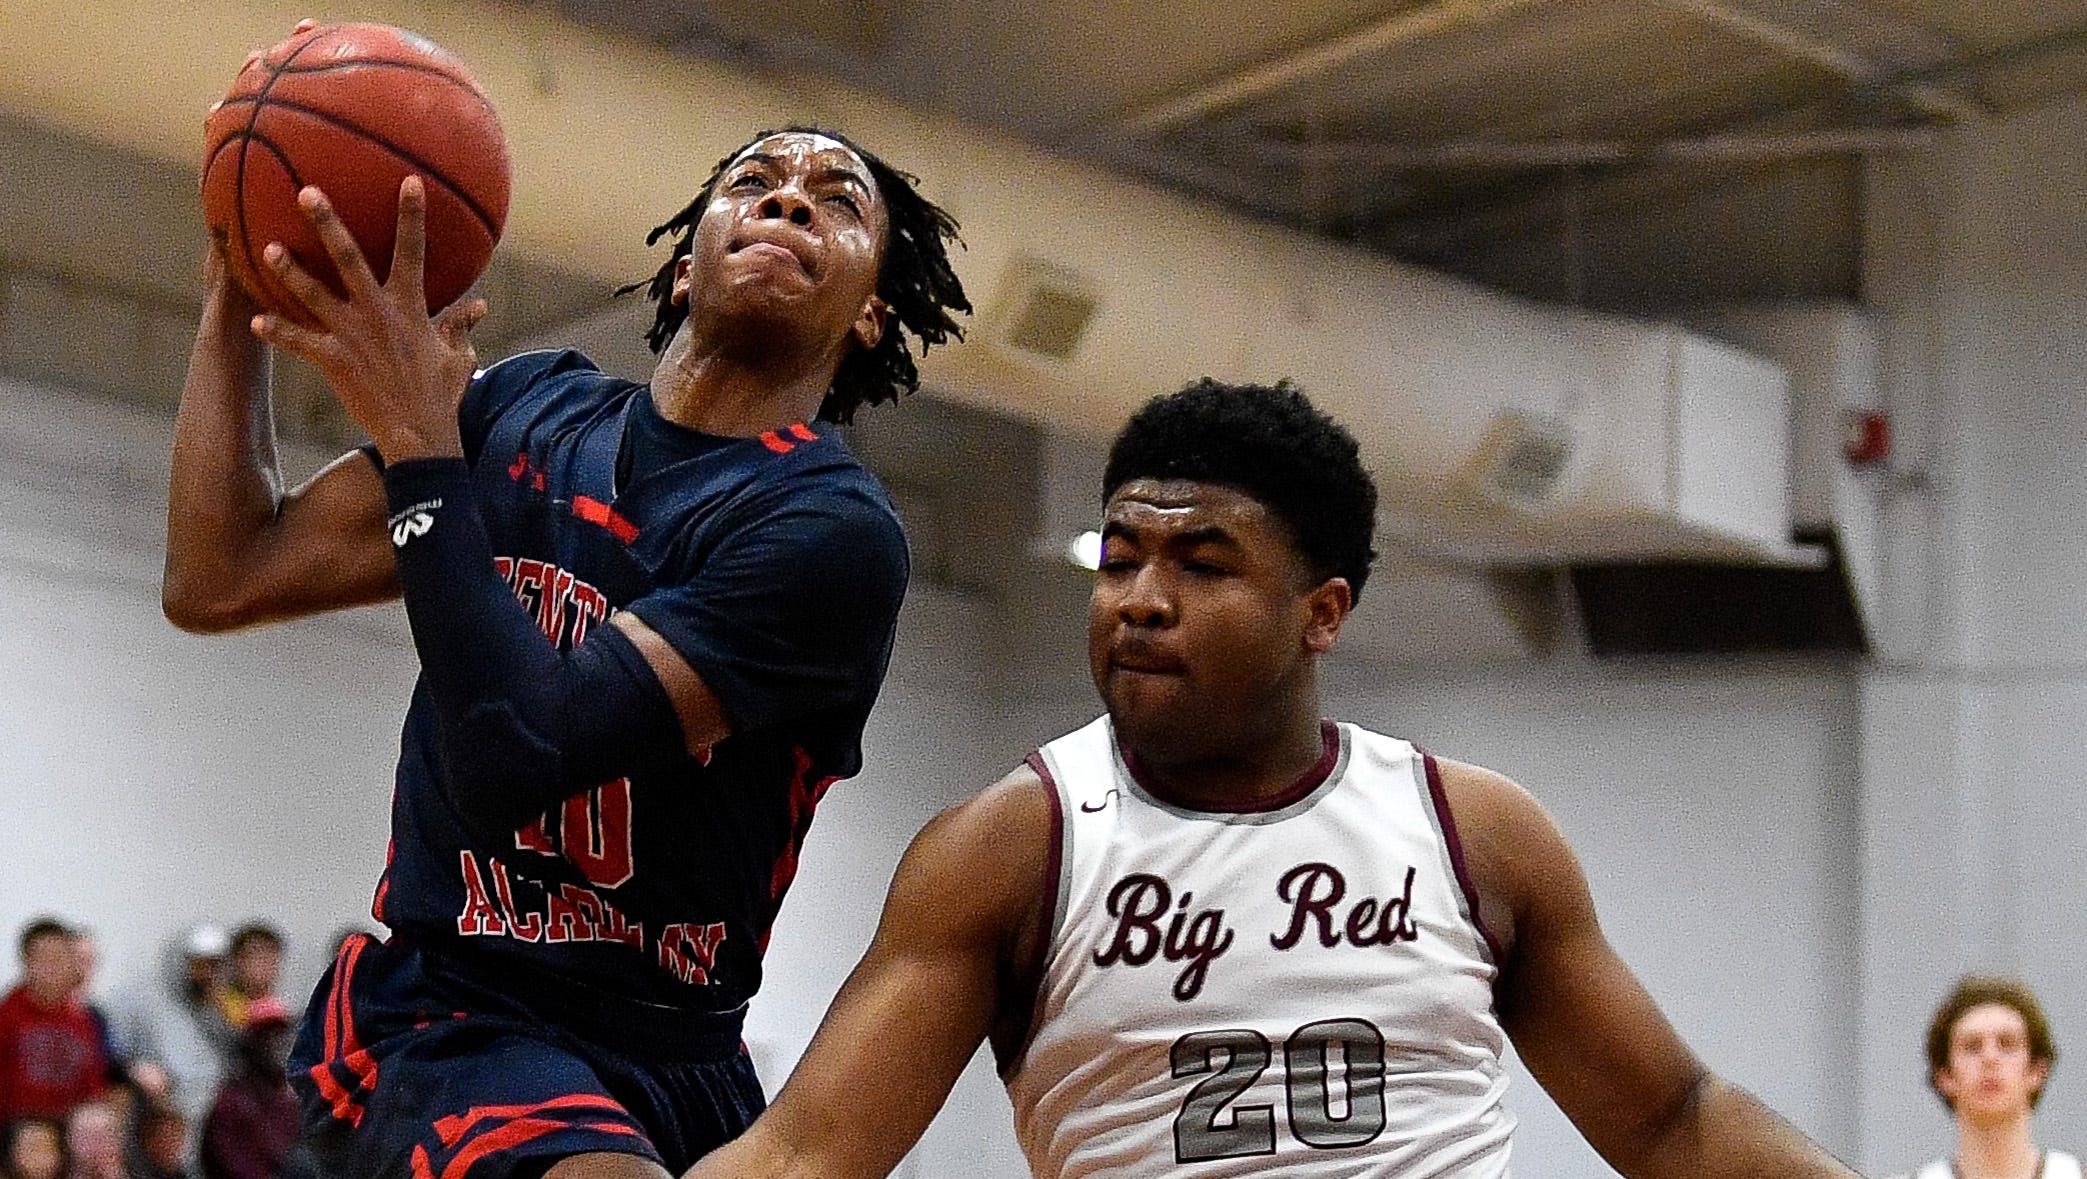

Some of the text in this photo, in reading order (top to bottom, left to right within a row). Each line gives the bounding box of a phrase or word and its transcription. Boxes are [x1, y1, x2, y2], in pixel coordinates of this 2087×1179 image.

[1094, 862, 1420, 1003] Big Red
[1169, 1017, 1388, 1165] 20
